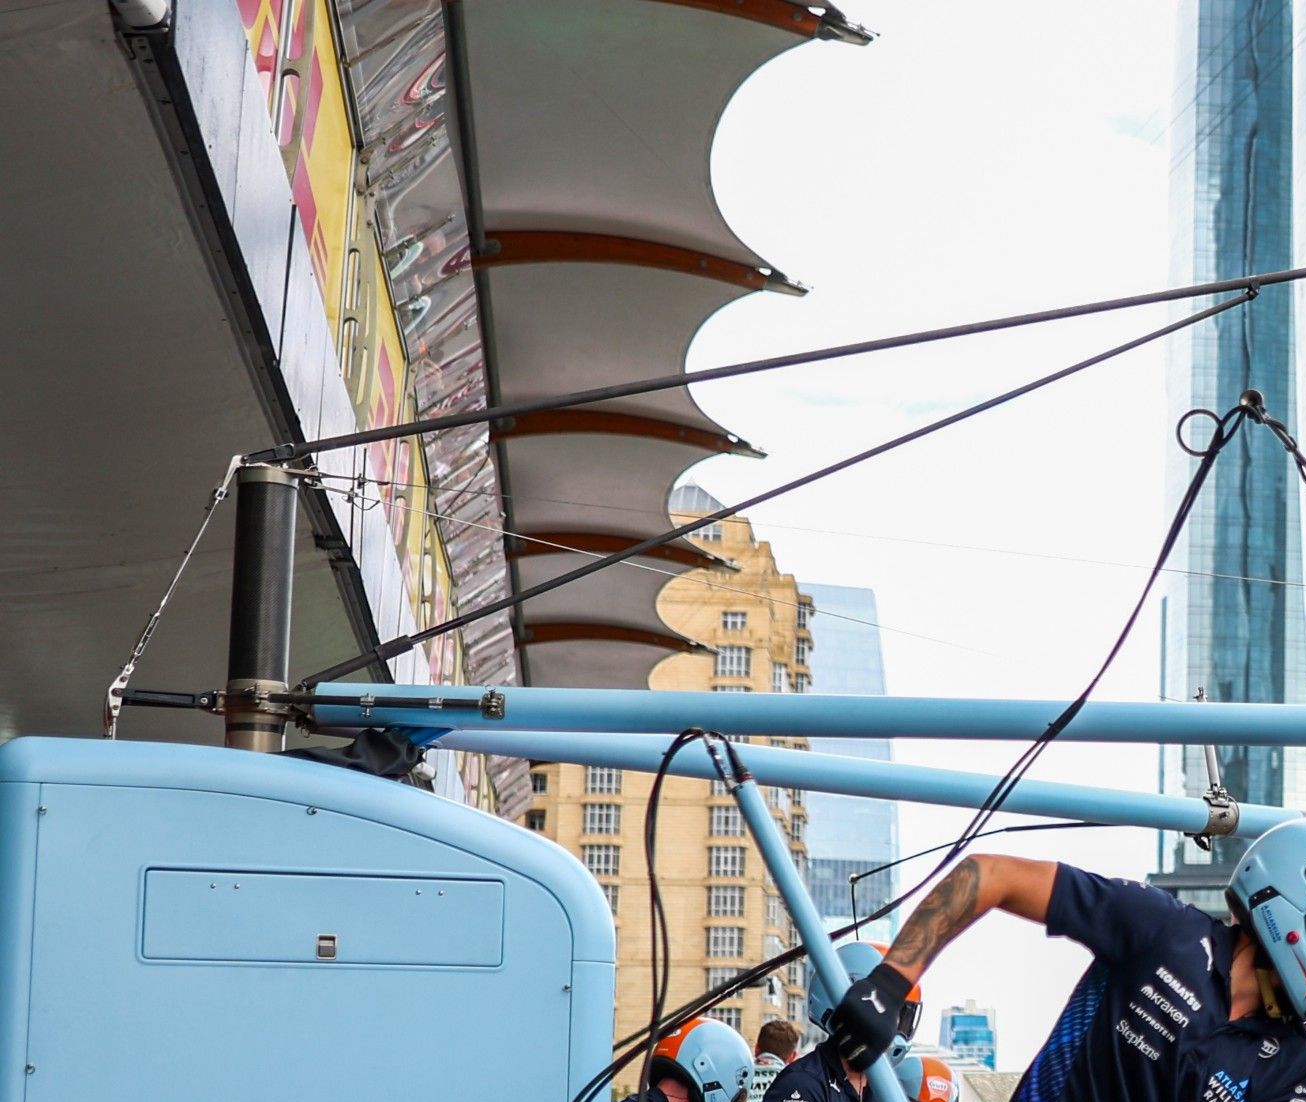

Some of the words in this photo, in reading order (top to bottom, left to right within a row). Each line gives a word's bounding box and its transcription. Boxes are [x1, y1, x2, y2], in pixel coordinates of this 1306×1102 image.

[1155, 967, 1202, 1012] KOMATSU
[1115, 1019, 1160, 1061] Stephens
[1135, 1007, 1176, 1043] MYPROTEIN
